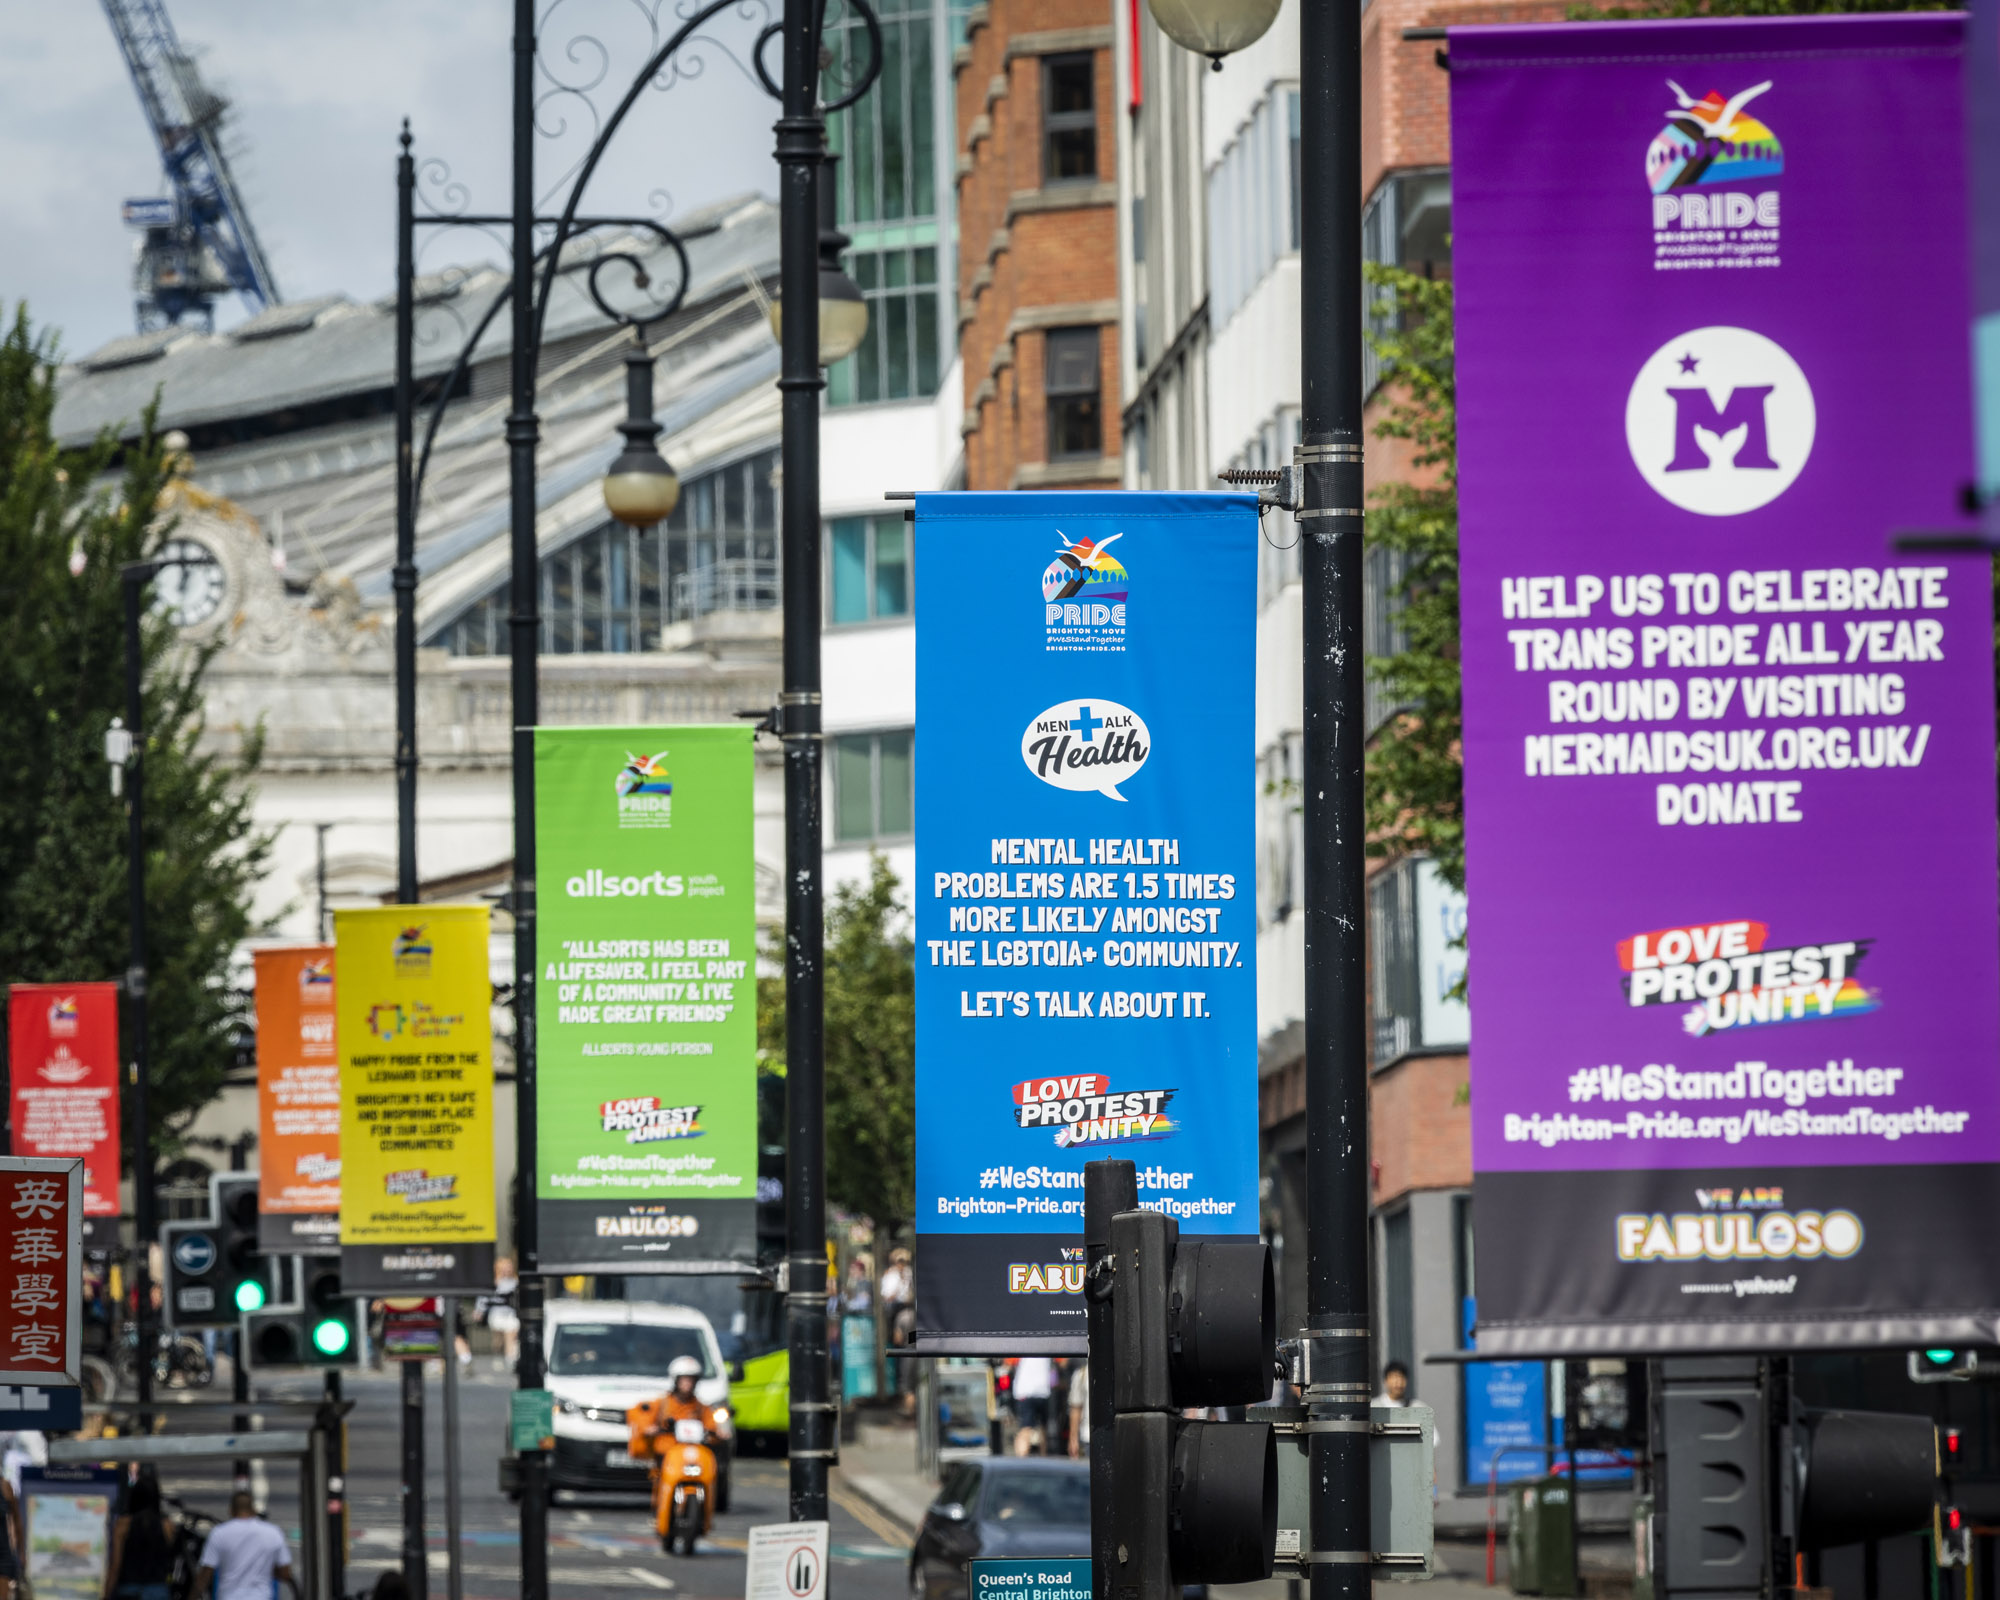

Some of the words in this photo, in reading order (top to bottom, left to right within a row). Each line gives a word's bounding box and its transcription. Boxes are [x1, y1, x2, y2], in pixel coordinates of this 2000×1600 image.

[1653, 191, 1780, 230] PRIDE
[1664, 384, 1780, 473] M
[1500, 574, 1604, 619] HELP
[1611, 574, 1664, 617] US
[1669, 572, 1720, 616] TO
[1727, 566, 1949, 614] CELEBRATE
[1046, 604, 1126, 626] PRIDE
[1507, 626, 1634, 671] TRANS
[1641, 623, 1760, 668] PRIDE
[1765, 621, 1839, 665] ALL
[1844, 618, 1945, 663] YEAR
[1548, 678, 1680, 723] ROUND
[1688, 676, 1738, 720] BY
[1741, 673, 1906, 719] VISITING
[1028, 729, 1148, 778] Health
[1524, 724, 1931, 776] MERMAIDSUK.ORG.UK/
[1656, 780, 1802, 826] DONATE
[991, 838, 1084, 865] MENTAL
[1089, 839, 1180, 865] HEALTH
[566, 869, 684, 897] allsorts
[934, 872, 1065, 899] PROBLEMS
[1069, 873, 1119, 899] ARE
[1123, 872, 1159, 900] 1.5
[1164, 873, 1236, 900] TIMES
[950, 906, 1016, 933] MORE
[1022, 906, 1108, 933] LIKELY
[1111, 907, 1222, 934] AMONGST
[653, 940, 684, 958] HAS
[687, 939, 730, 958] BEEN
[927, 940, 976, 967] THE
[981, 940, 1098, 968] LGBTQIA+
[1103, 941, 1243, 968] COMMUNITY.
[1632, 921, 1750, 970] LOVE
[545, 962, 556, 980] A
[558, 962, 649, 981] LIFESAVER,
[652, 961, 659, 980] I
[661, 961, 704, 979] FEEL
[706, 960, 747, 979] PART
[1629, 941, 1856, 1007] PROTEST
[558, 984, 581, 1002] OF
[582, 984, 593, 1002] A
[595, 983, 685, 1002] COMMUNITY
[686, 983, 700, 1000] &
[702, 982, 734, 1000] I'VE
[961, 991, 1030, 1018] LET'S
[1035, 991, 1095, 1018] TALK
[1099, 992, 1178, 1018] ABOUT
[1183, 992, 1211, 1018] IT.
[1705, 981, 1844, 1030] UNITY
[558, 1005, 600, 1024] MADE
[602, 1004, 654, 1023] GREAT
[581, 1043, 636, 1056] ALLSORTS
[671, 1043, 713, 1055] PERSON
[1022, 1075, 1097, 1103] LOVE
[1568, 1058, 1903, 1106] #WeStandTogether
[603, 1106, 698, 1131] PROTEST
[604, 1097, 655, 1117] LOVE
[1020, 1090, 1165, 1128] PROTEST
[634, 1121, 690, 1142] UNITY
[1070, 1114, 1157, 1143] UNITY
[1695, 1188, 1733, 1209] WE
[1736, 1187, 1784, 1209] ARE
[595, 1215, 699, 1237] FABULOSO
[1617, 1210, 1863, 1262] FABULOSO
[1060, 1248, 1084, 1261] WE
[10, 1179, 66, 1365] 英華學堂
[979, 1572, 1034, 1588] Queen's
[1038, 1571, 1072, 1585] Road
[979, 1589, 1028, 1600] Central
[1033, 1588, 1092, 1600] Brighton
